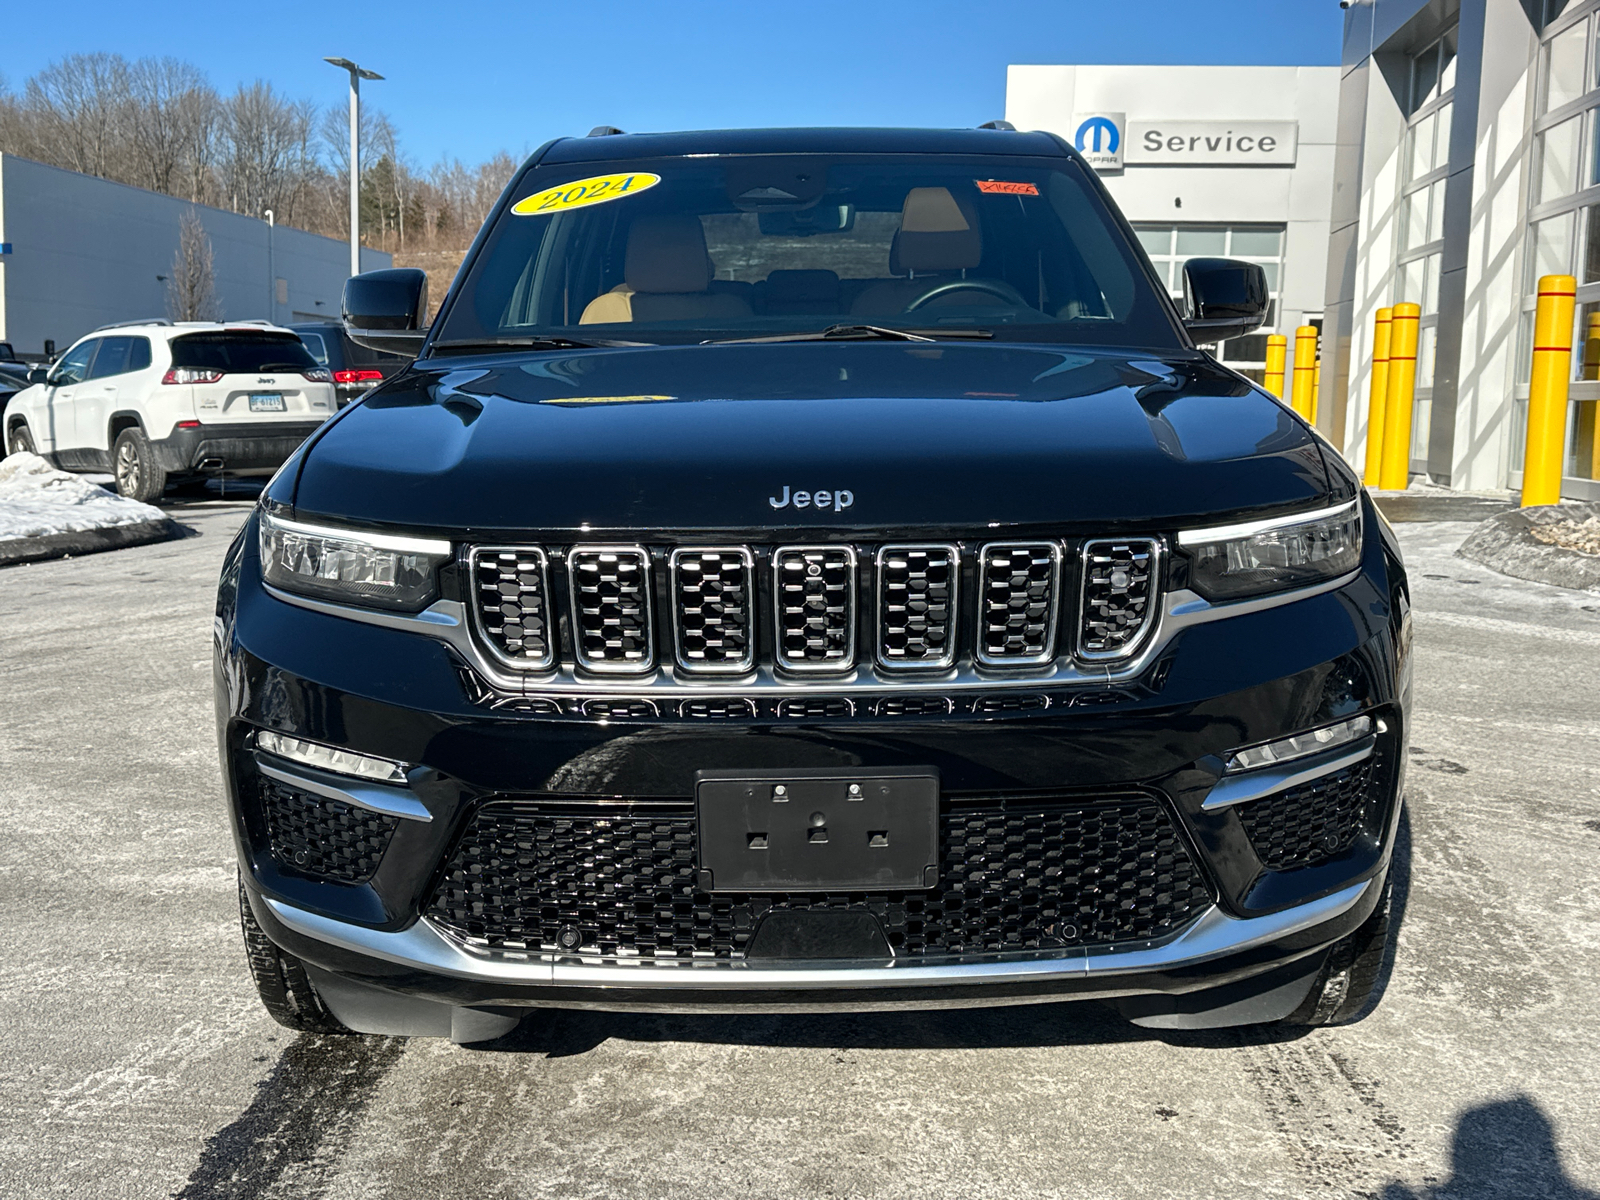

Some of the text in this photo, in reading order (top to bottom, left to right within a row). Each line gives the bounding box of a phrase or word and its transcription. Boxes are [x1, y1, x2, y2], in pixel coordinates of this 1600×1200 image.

[1143, 130, 1277, 153] Service
[536, 176, 635, 211] 2024
[769, 485, 854, 512] Jeep
